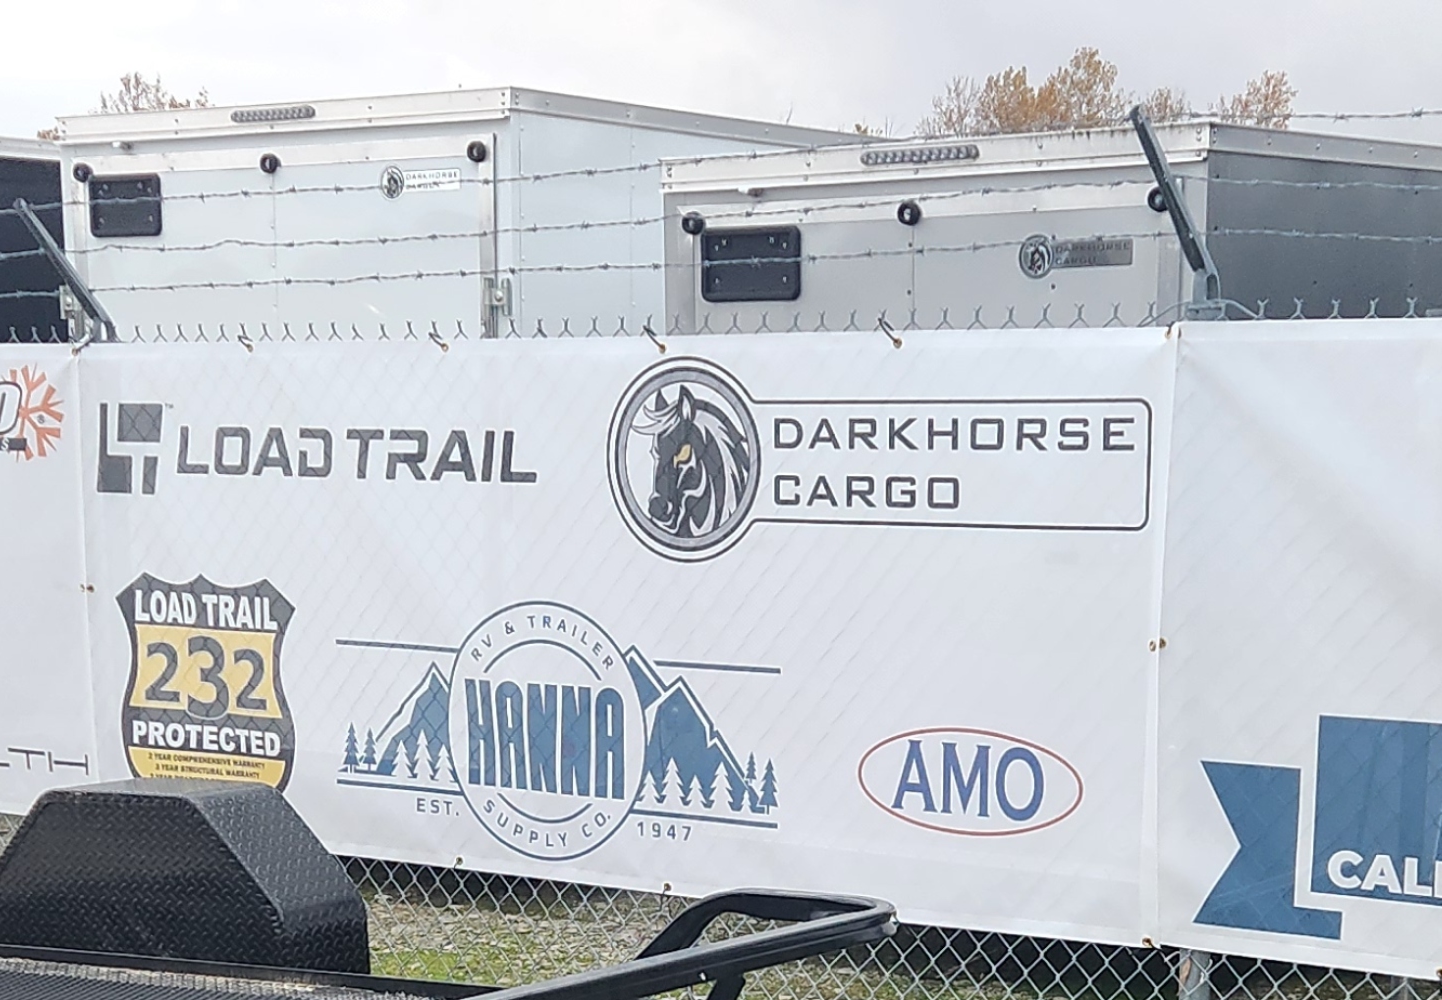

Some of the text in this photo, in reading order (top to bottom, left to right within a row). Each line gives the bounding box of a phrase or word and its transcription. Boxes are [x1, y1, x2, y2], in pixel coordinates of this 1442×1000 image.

[773, 417, 1135, 451] DARKHORSE
[177, 426, 538, 483] LOAD TRAIL
[773, 475, 960, 509] CARGO
[135, 590, 278, 631] LOAD TRAIL
[471, 615, 614, 670] RV & TRAILER
[145, 635, 268, 720] 232
[132, 720, 281, 757] PROTECTED
[465, 678, 625, 800] HANNA
[154, 753, 172, 762] YEAR
[173, 755, 231, 767] COMPREHENSIVE
[233, 759, 266, 770] WARRANTY
[161, 764, 179, 772] YEAR
[180, 766, 224, 776] STRUCTURAL
[226, 769, 260, 779] WARRANTY
[891, 739, 1045, 822] AMO
[416, 798, 459, 816] EST.
[483, 799, 611, 848] SUPPLY CO.
[637, 821, 692, 842] 1947
